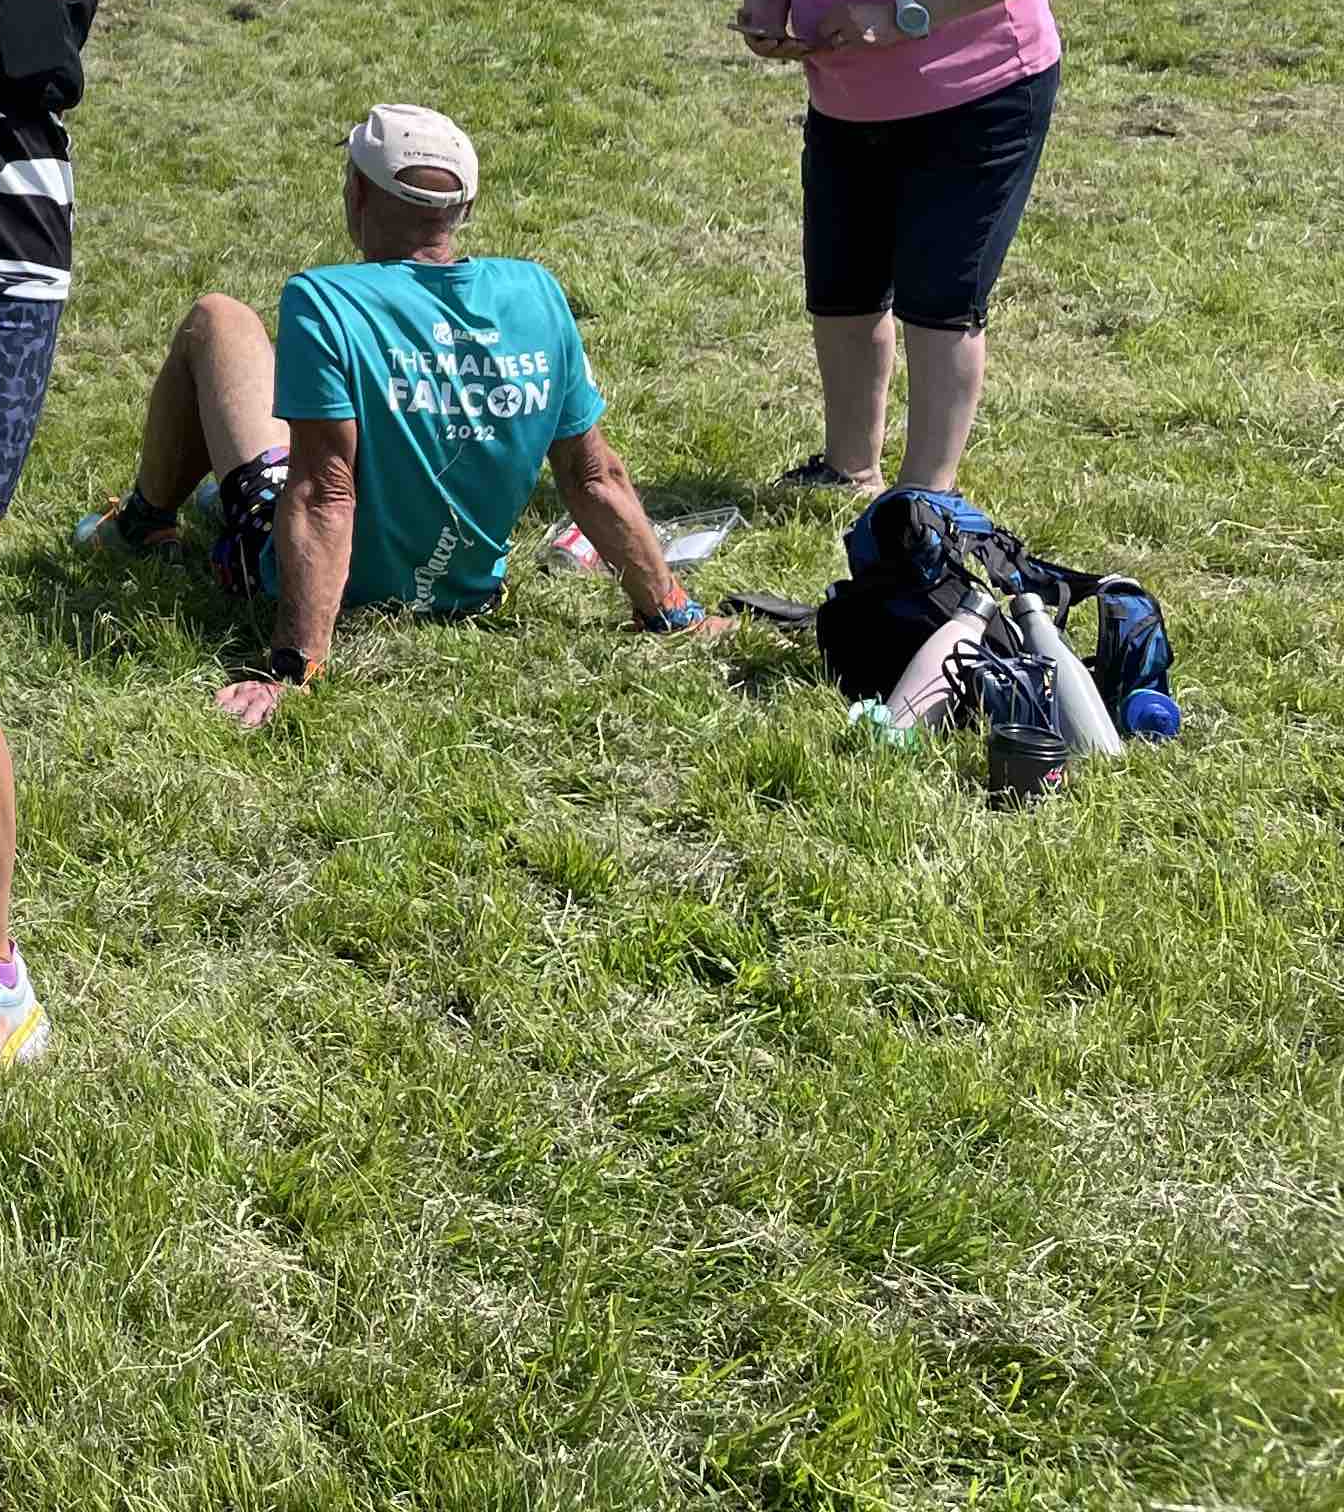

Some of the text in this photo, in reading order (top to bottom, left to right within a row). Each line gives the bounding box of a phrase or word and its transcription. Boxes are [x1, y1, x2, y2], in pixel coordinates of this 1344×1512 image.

[387, 347, 550, 378] THE MALTESE
[388, 377, 551, 418] FALCON
[446, 424, 496, 441] 2022
